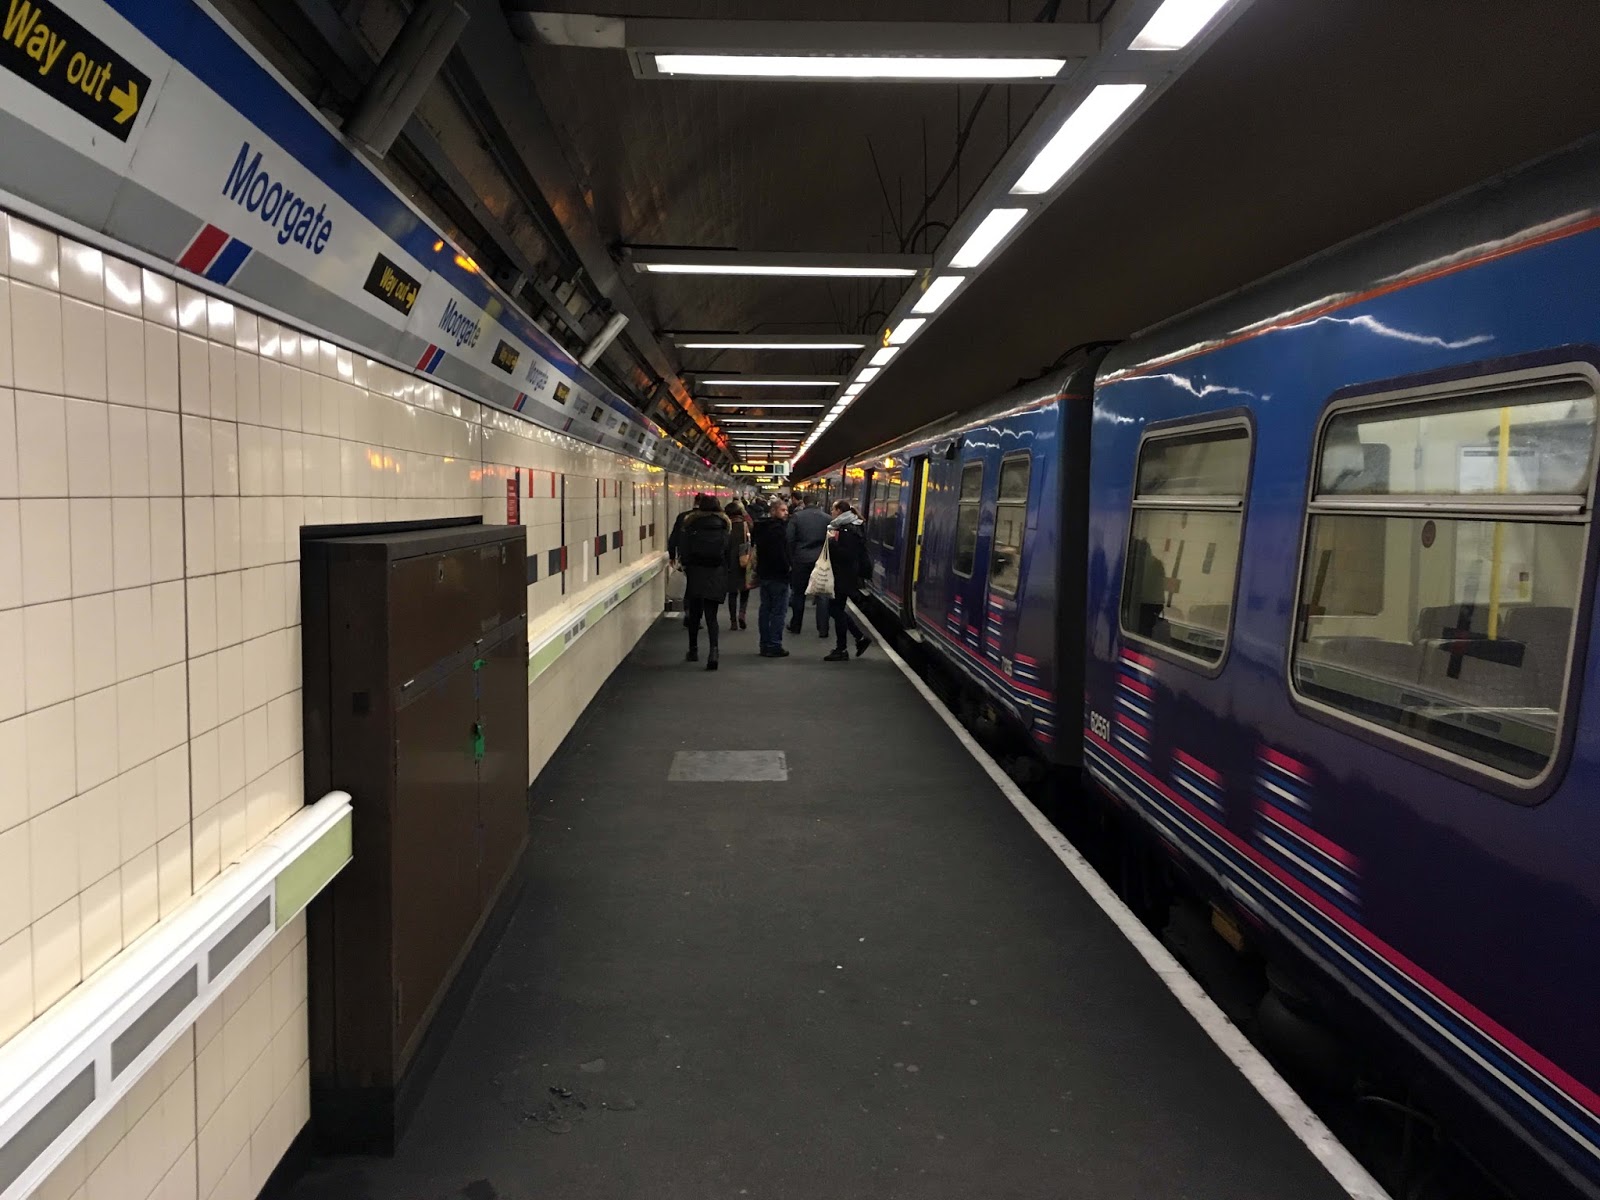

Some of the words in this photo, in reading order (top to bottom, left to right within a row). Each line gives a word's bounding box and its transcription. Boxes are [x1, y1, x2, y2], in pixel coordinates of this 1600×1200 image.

[2, 0, 67, 76] Way
[66, 51, 112, 102] out
[222, 141, 332, 254] Moorgate
[380, 265, 399, 297] Way
[394, 281, 411, 302] out
[438, 297, 481, 348] Moorgate
[1090, 710, 1110, 742] 62551
